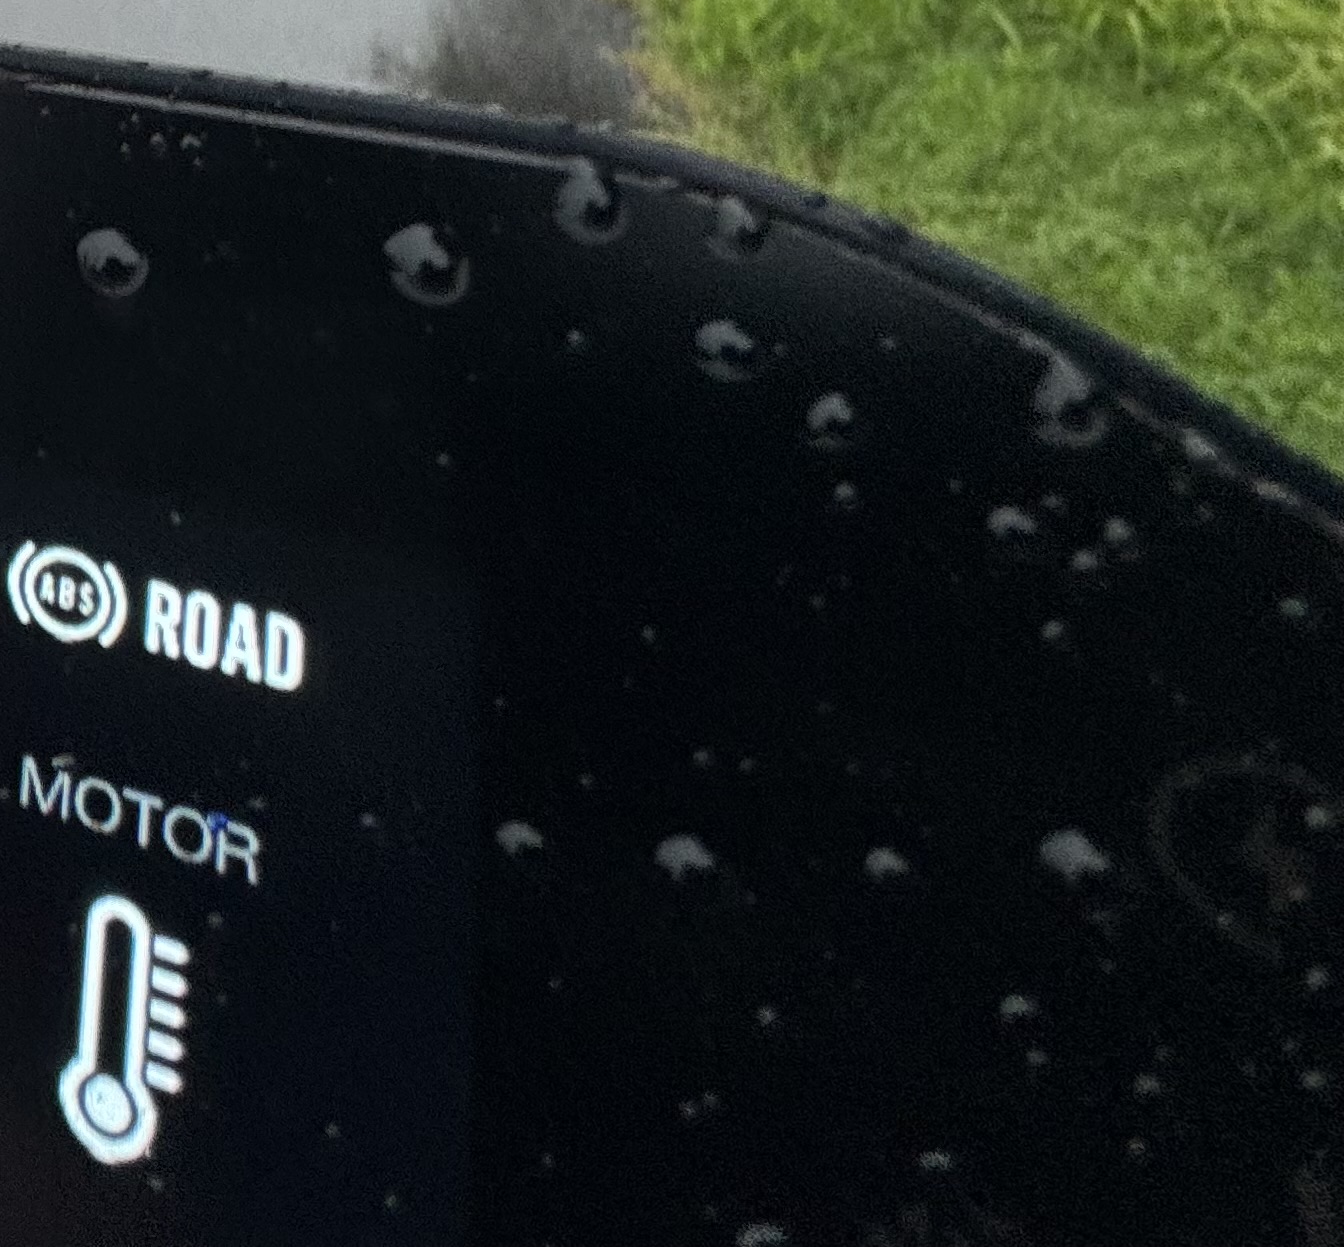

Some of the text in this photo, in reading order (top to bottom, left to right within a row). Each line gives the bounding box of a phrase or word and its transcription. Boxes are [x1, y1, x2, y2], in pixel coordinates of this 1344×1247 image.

[38, 570, 305, 692] ABS ROAD
[19, 755, 261, 886] MOTOR
